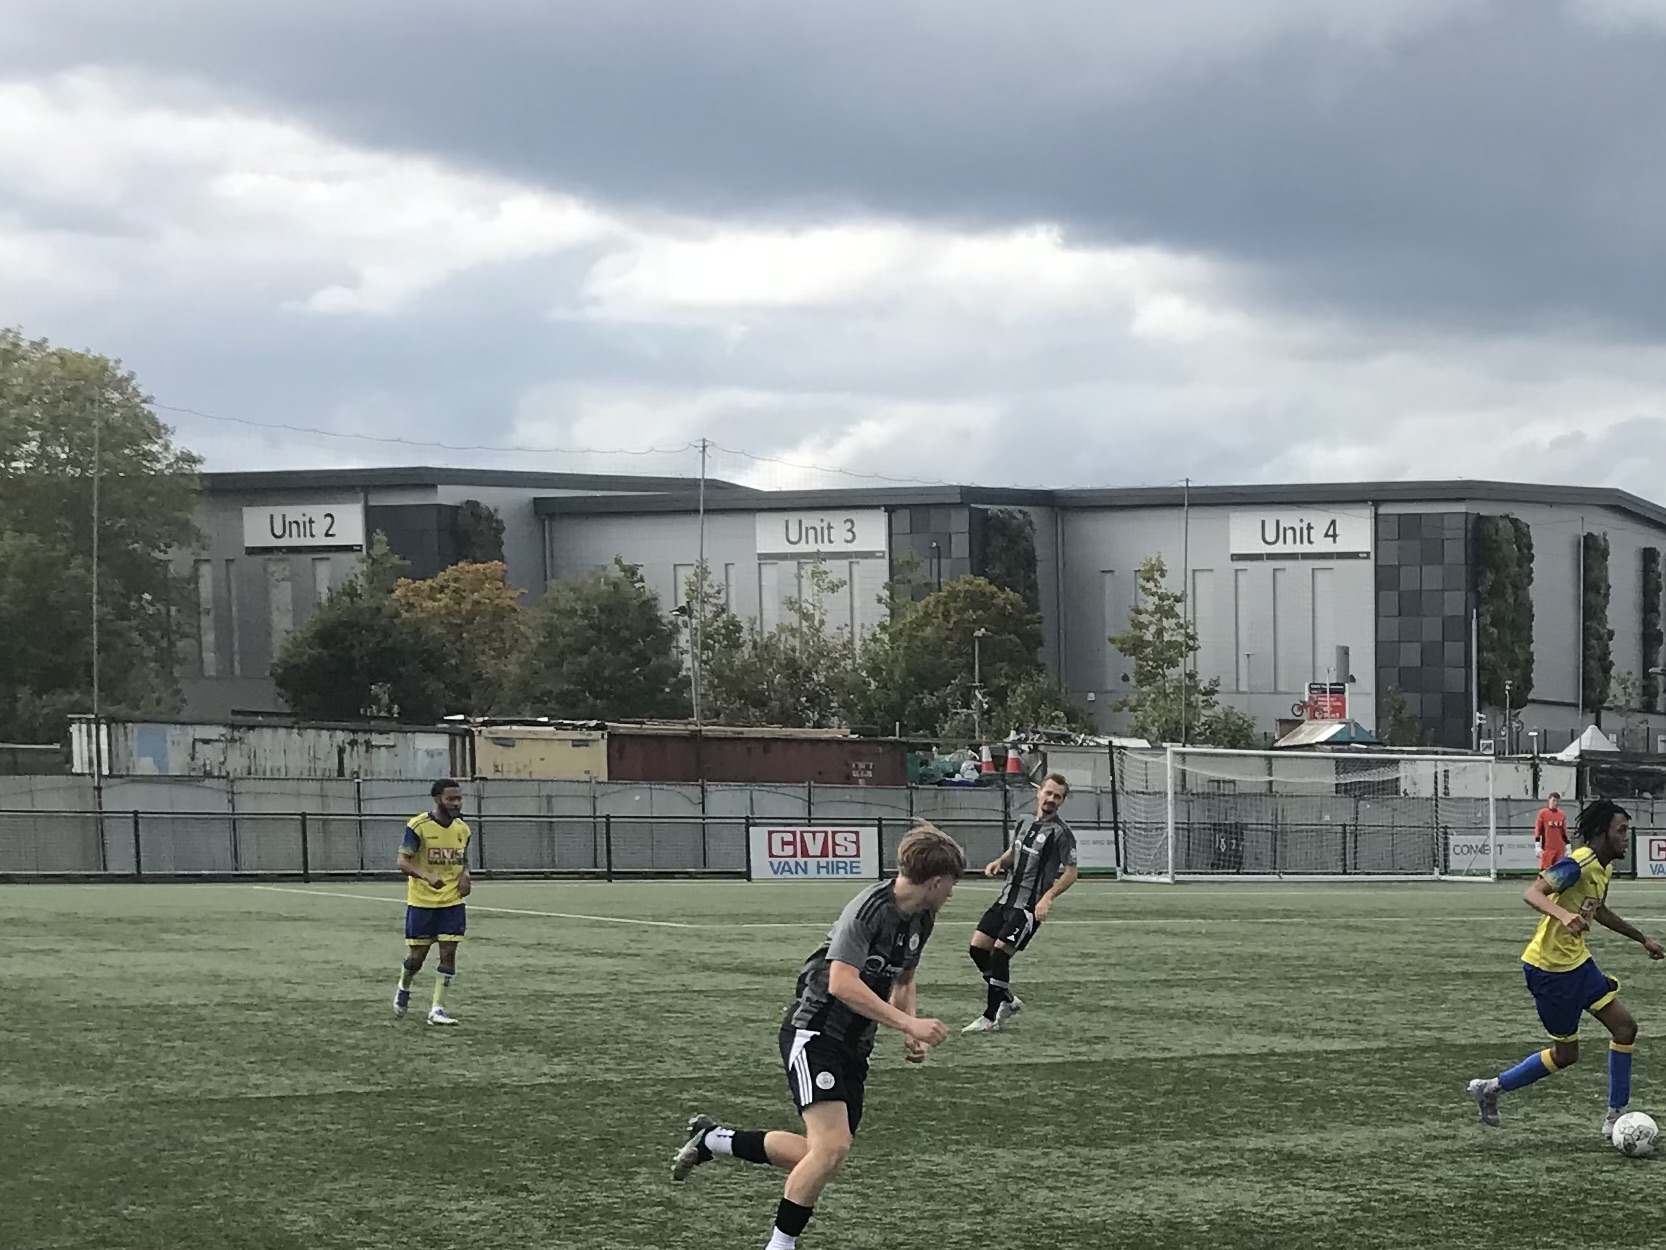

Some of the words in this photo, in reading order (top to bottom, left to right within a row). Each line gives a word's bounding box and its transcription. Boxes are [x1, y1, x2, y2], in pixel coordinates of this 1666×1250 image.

[269, 512, 316, 539] Unit
[323, 512, 336, 538] 2
[784, 518, 835, 546] Unit
[843, 518, 857, 544] 3
[1261, 518, 1315, 546] Unit
[1323, 519, 1340, 545] 4
[769, 831, 860, 858] CVS
[768, 860, 808, 875] VAN
[816, 860, 862, 875] HIRE
